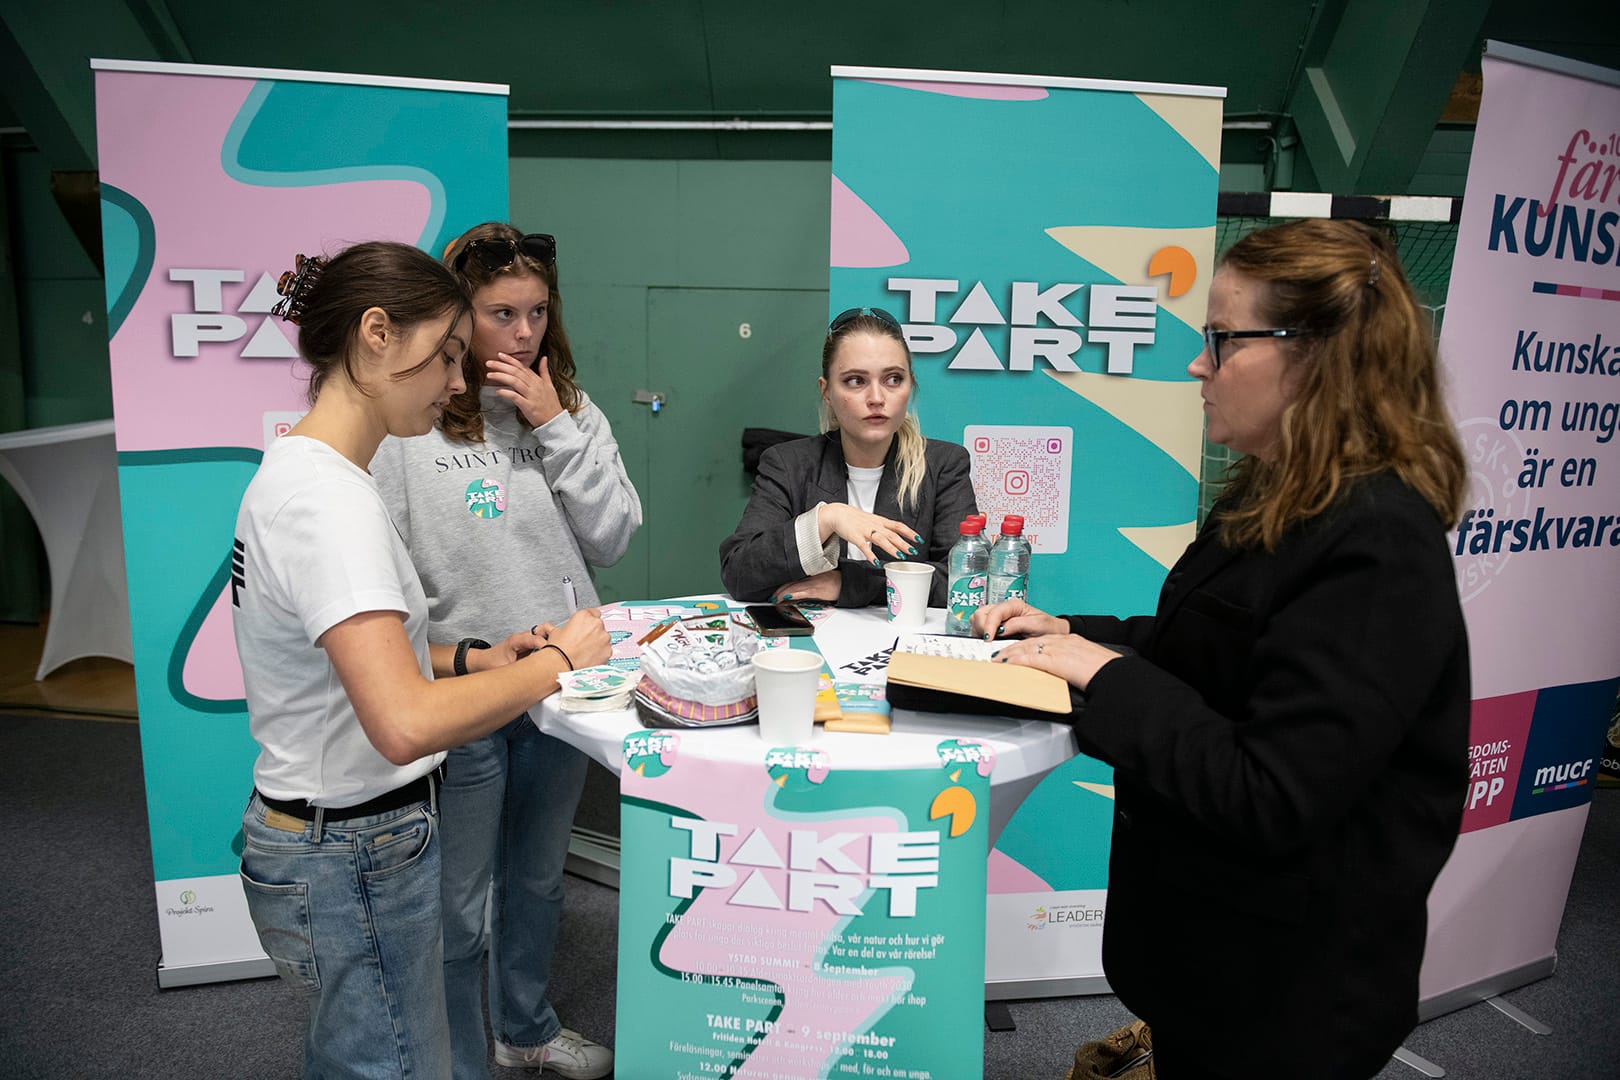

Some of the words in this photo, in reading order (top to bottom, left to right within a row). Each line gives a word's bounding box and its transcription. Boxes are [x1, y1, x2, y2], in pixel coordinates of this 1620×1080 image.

[1536, 129, 1620, 218] fär
[1488, 194, 1620, 267] KUNS
[887, 278, 1158, 329] TAKE
[739, 323, 751, 338] 6
[900, 324, 1156, 374] PART
[1500, 399, 1551, 431] om
[1561, 401, 1620, 443] ung
[435, 450, 502, 473] SAINT
[1517, 448, 1554, 488] är
[1560, 458, 1597, 487] en
[1468, 756, 1508, 778] ÄTEN
[1463, 777, 1504, 810] PP
[671, 816, 940, 874] TAKE
[669, 856, 938, 917] PART
[665, 912, 684, 925] TAKE
[848, 933, 861, 944] vår
[863, 935, 887, 945] natur
[888, 934, 903, 946] och
[905, 934, 919, 946] hur
[921, 934, 929, 945] vi
[931, 934, 945, 947] gör
[1048, 910, 1104, 924] LEADER
[728, 952, 757, 965] YSTAD
[760, 955, 800, 969] SUMMIT
[823, 962, 879, 976] September
[832, 946, 846, 956] Var
[848, 948, 859, 958] en
[861, 947, 874, 958] del
[876, 949, 886, 959] av
[888, 948, 901, 959] vår
[681, 972, 703, 985] 15.00
[711, 974, 734, 988] 15.45
[907, 993, 927, 1007] ihop
[706, 1013, 741, 1031] TAKE
[745, 1018, 782, 1034] PART
[801, 1025, 811, 1038] 9
[816, 1030, 896, 1047] september
[712, 1031, 745, 1044] Fritiden
[863, 1049, 889, 1060] 18.00
[699, 1061, 727, 1074] 12.00
[840, 1063, 860, 1075] med,
[862, 1063, 875, 1075] för
[876, 1065, 891, 1077] och
[893, 1068, 907, 1078] om
